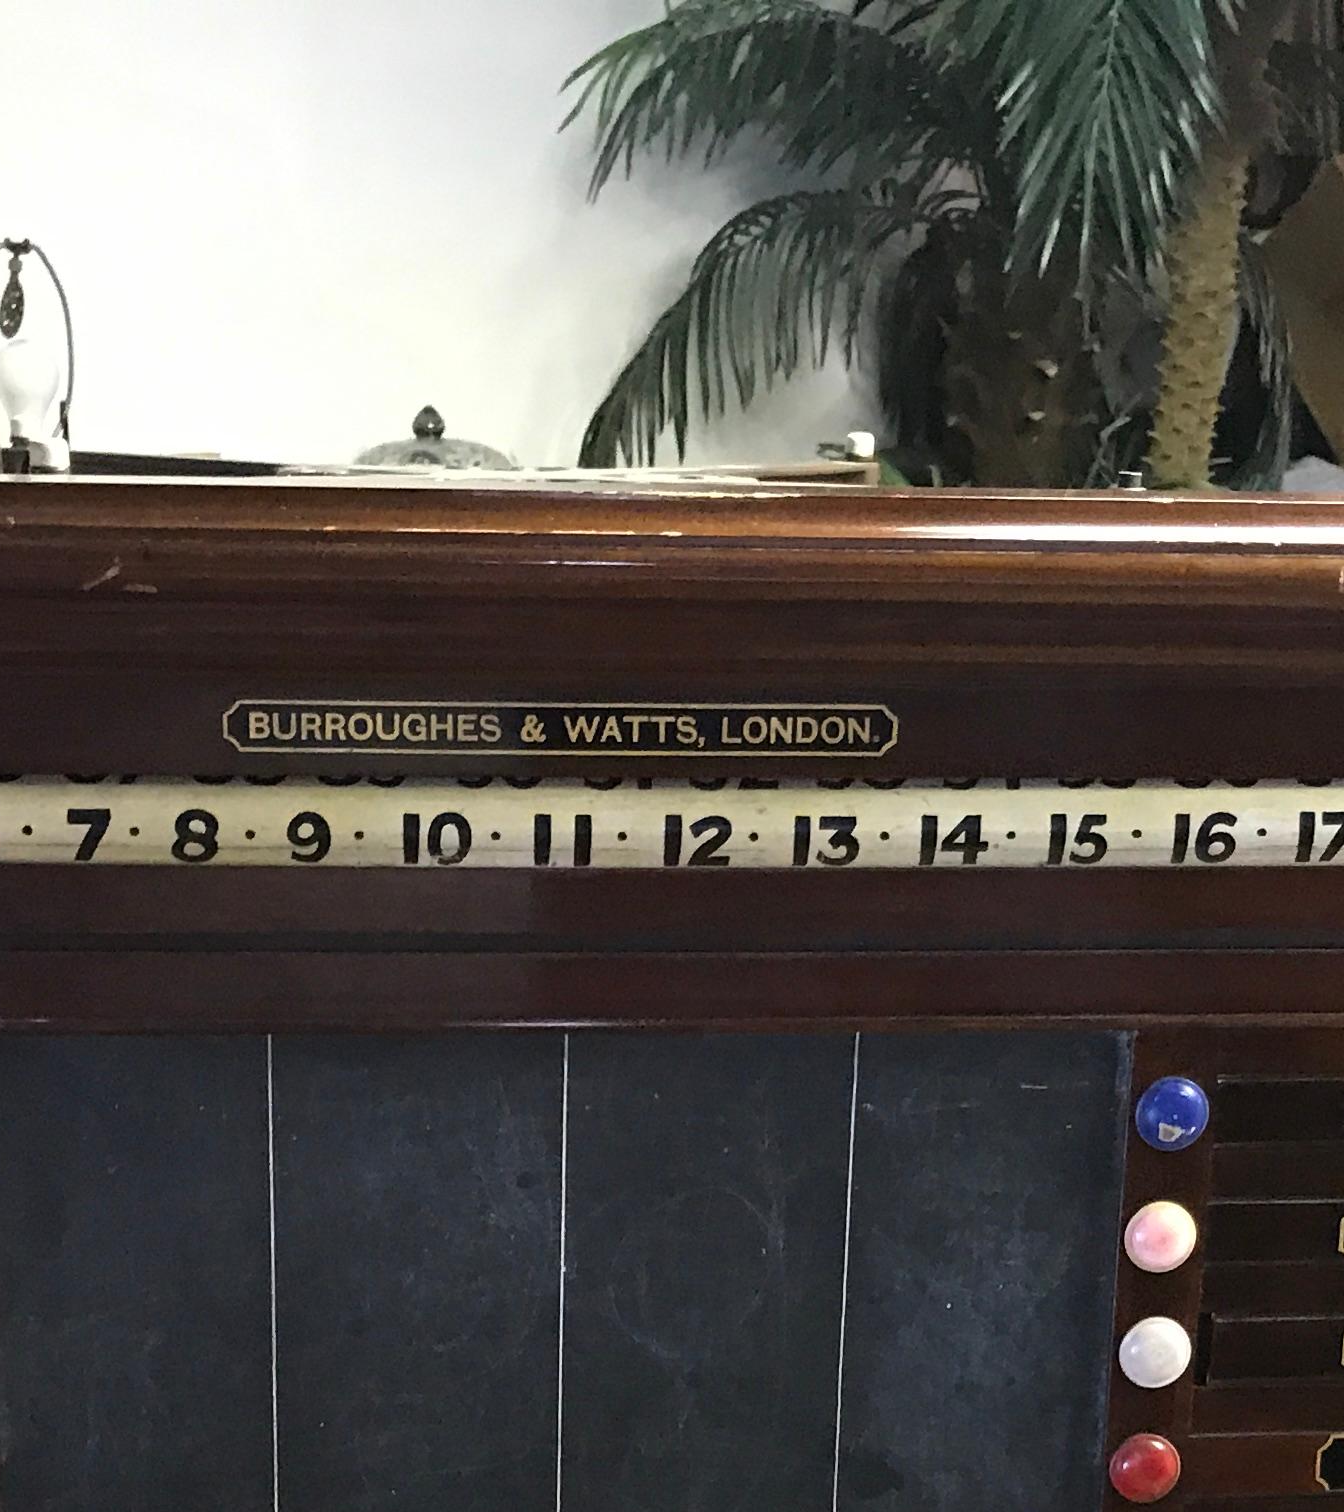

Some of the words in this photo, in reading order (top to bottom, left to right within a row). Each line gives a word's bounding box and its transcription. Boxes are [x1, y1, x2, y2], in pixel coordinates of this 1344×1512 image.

[249, 712, 501, 743] BURROUGHES
[520, 715, 546, 743] &
[564, 715, 705, 748] WATTS,
[722, 716, 880, 744] LONDON.
[66, 808, 111, 860] 7
[170, 809, 219, 863] 8
[286, 812, 332, 862] 9
[403, 813, 471, 865] 10
[534, 814, 592, 866] 11
[663, 814, 732, 866] 12
[792, 815, 860, 866] 13
[919, 815, 988, 866] 14
[1050, 814, 1108, 865] 15
[1172, 812, 1237, 864] 16
